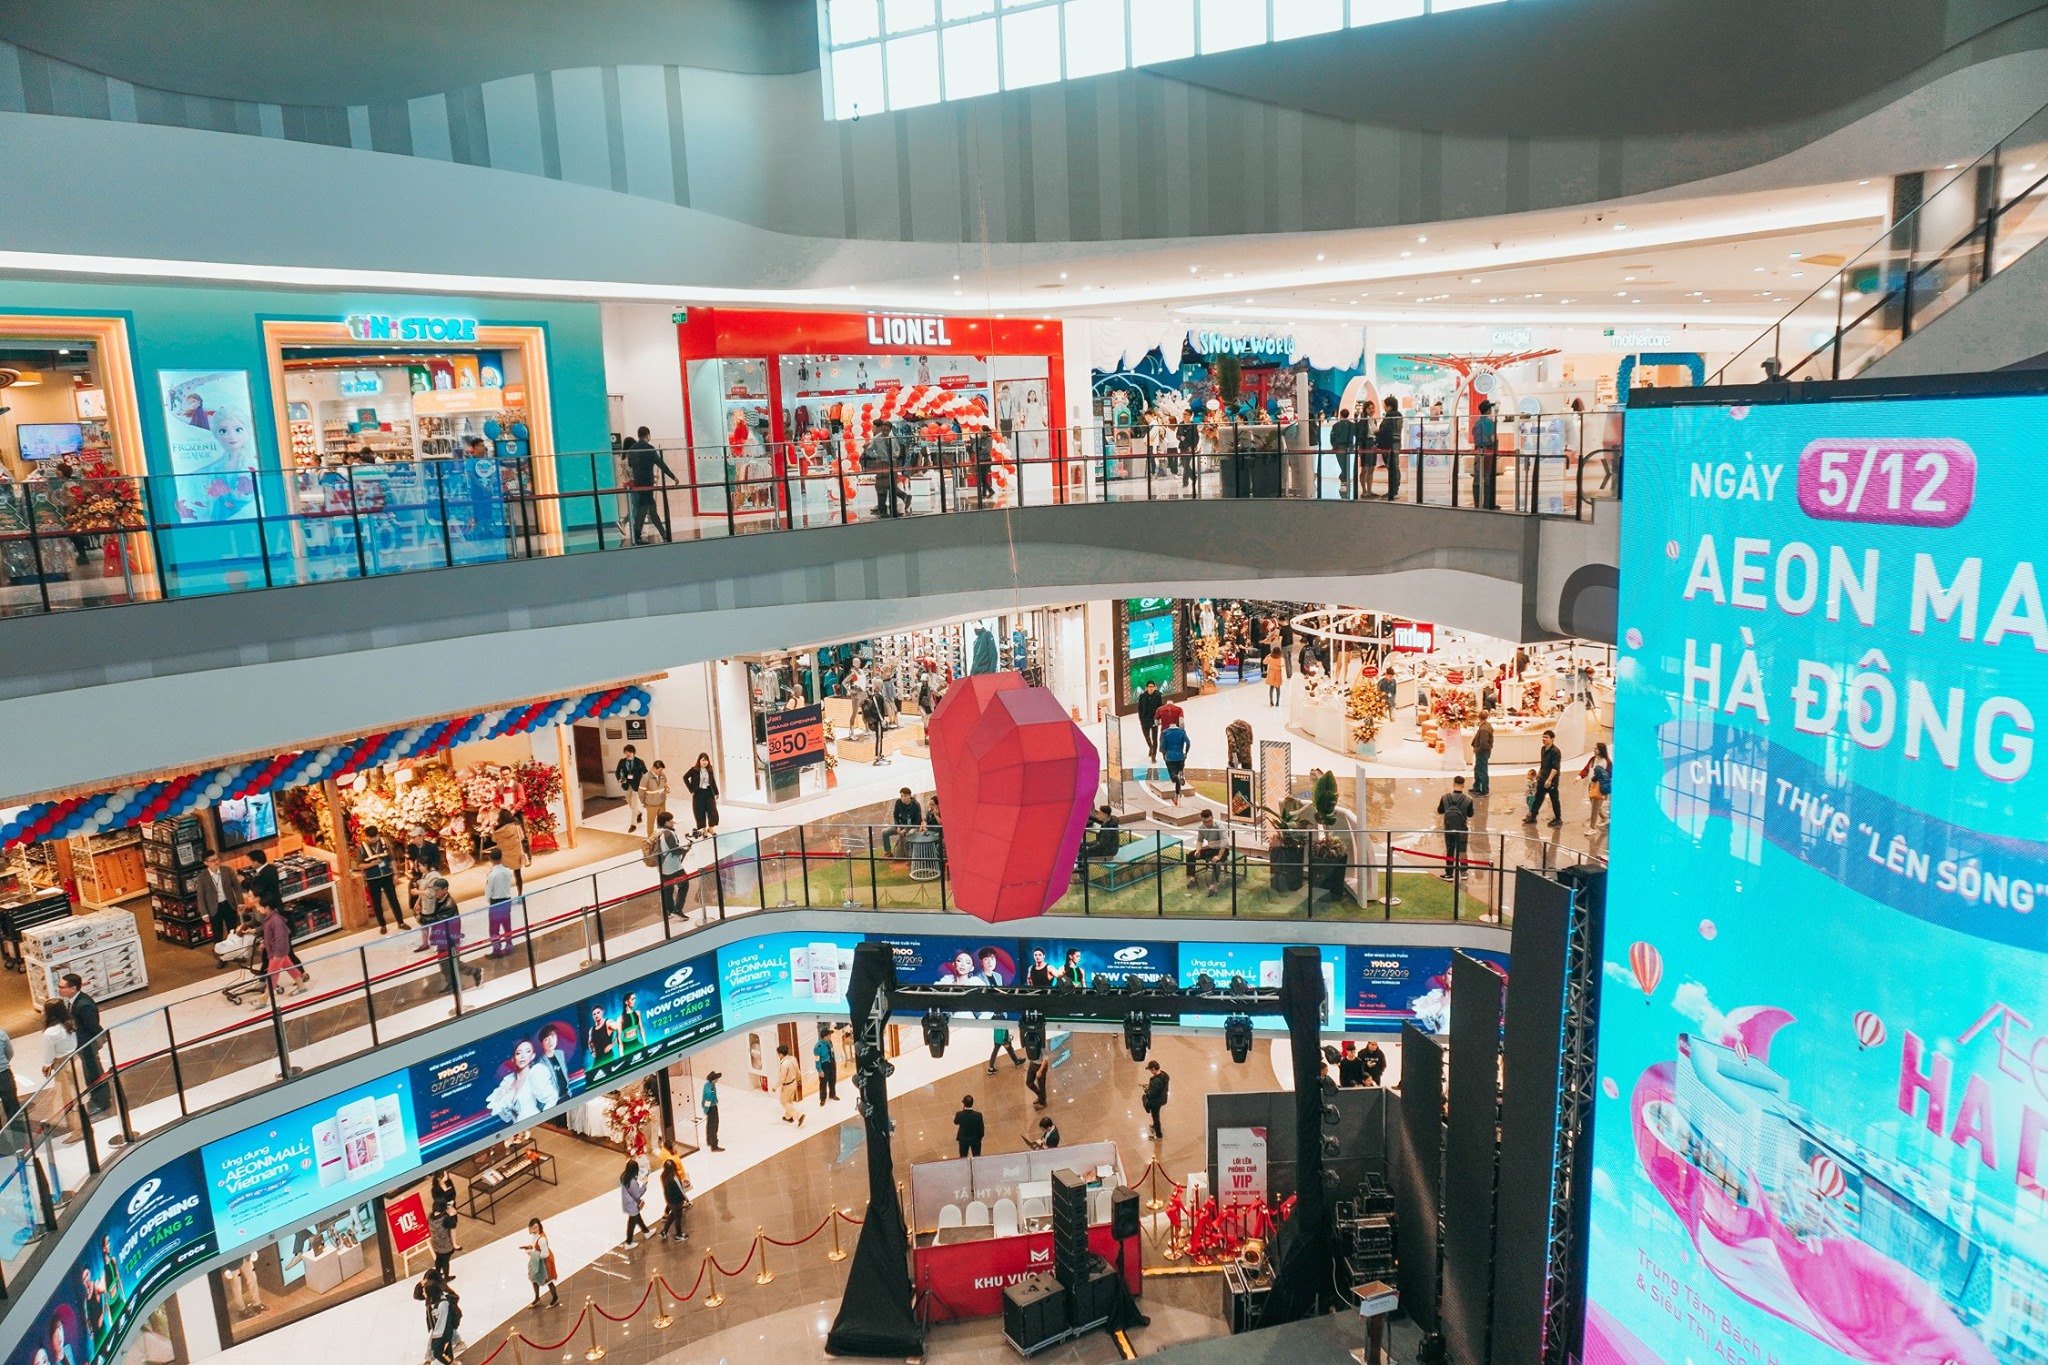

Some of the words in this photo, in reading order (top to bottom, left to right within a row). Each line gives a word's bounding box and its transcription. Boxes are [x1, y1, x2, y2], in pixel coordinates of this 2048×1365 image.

[401, 318, 476, 341] STORE
[867, 317, 951, 346] LIONEL
[1611, 331, 1671, 347] mothercare
[1200, 331, 1247, 355] SNOW
[172, 443, 209, 452] FROZEN
[1689, 451, 1784, 502] NGÀY
[1817, 447, 1950, 514] 5/12
[1682, 534, 1880, 628] AEON
[1682, 625, 1770, 725] HÀ
[1790, 647, 2036, 784] ĐÔNG
[789, 716, 817, 726] OPENING
[768, 740, 782, 752] 30
[782, 732, 807, 754] 50
[1689, 754, 1768, 797] CHÍNH
[1776, 777, 1851, 841] THỨC
[729, 970, 771, 987] Vietnam
[1363, 968, 1409, 978] 07/12/2019
[645, 1000, 671, 1019] NOW
[673, 983, 715, 1008] OPENING
[651, 1013, 673, 1029] T221
[705, 998, 711, 1008] 2
[430, 1067, 479, 1093] 07/12/2019
[226, 1163, 290, 1194] Vietnam
[1232, 1174, 1253, 1189] VIP
[118, 1231, 139, 1264] NOW
[139, 1194, 200, 1238] OPENING
[184, 1214, 194, 1227] 2
[177, 1242, 207, 1263] crocs
[974, 1275, 1004, 1290] KHU
[1636, 1273, 1647, 1292] &
[1651, 1285, 1683, 1322] Siêu
[1686, 1312, 1712, 1349] Thị
[1638, 1247, 1680, 1296] Trung
[1684, 1284, 1717, 1324] Tâm
[1721, 1315, 1762, 1360] Bách
